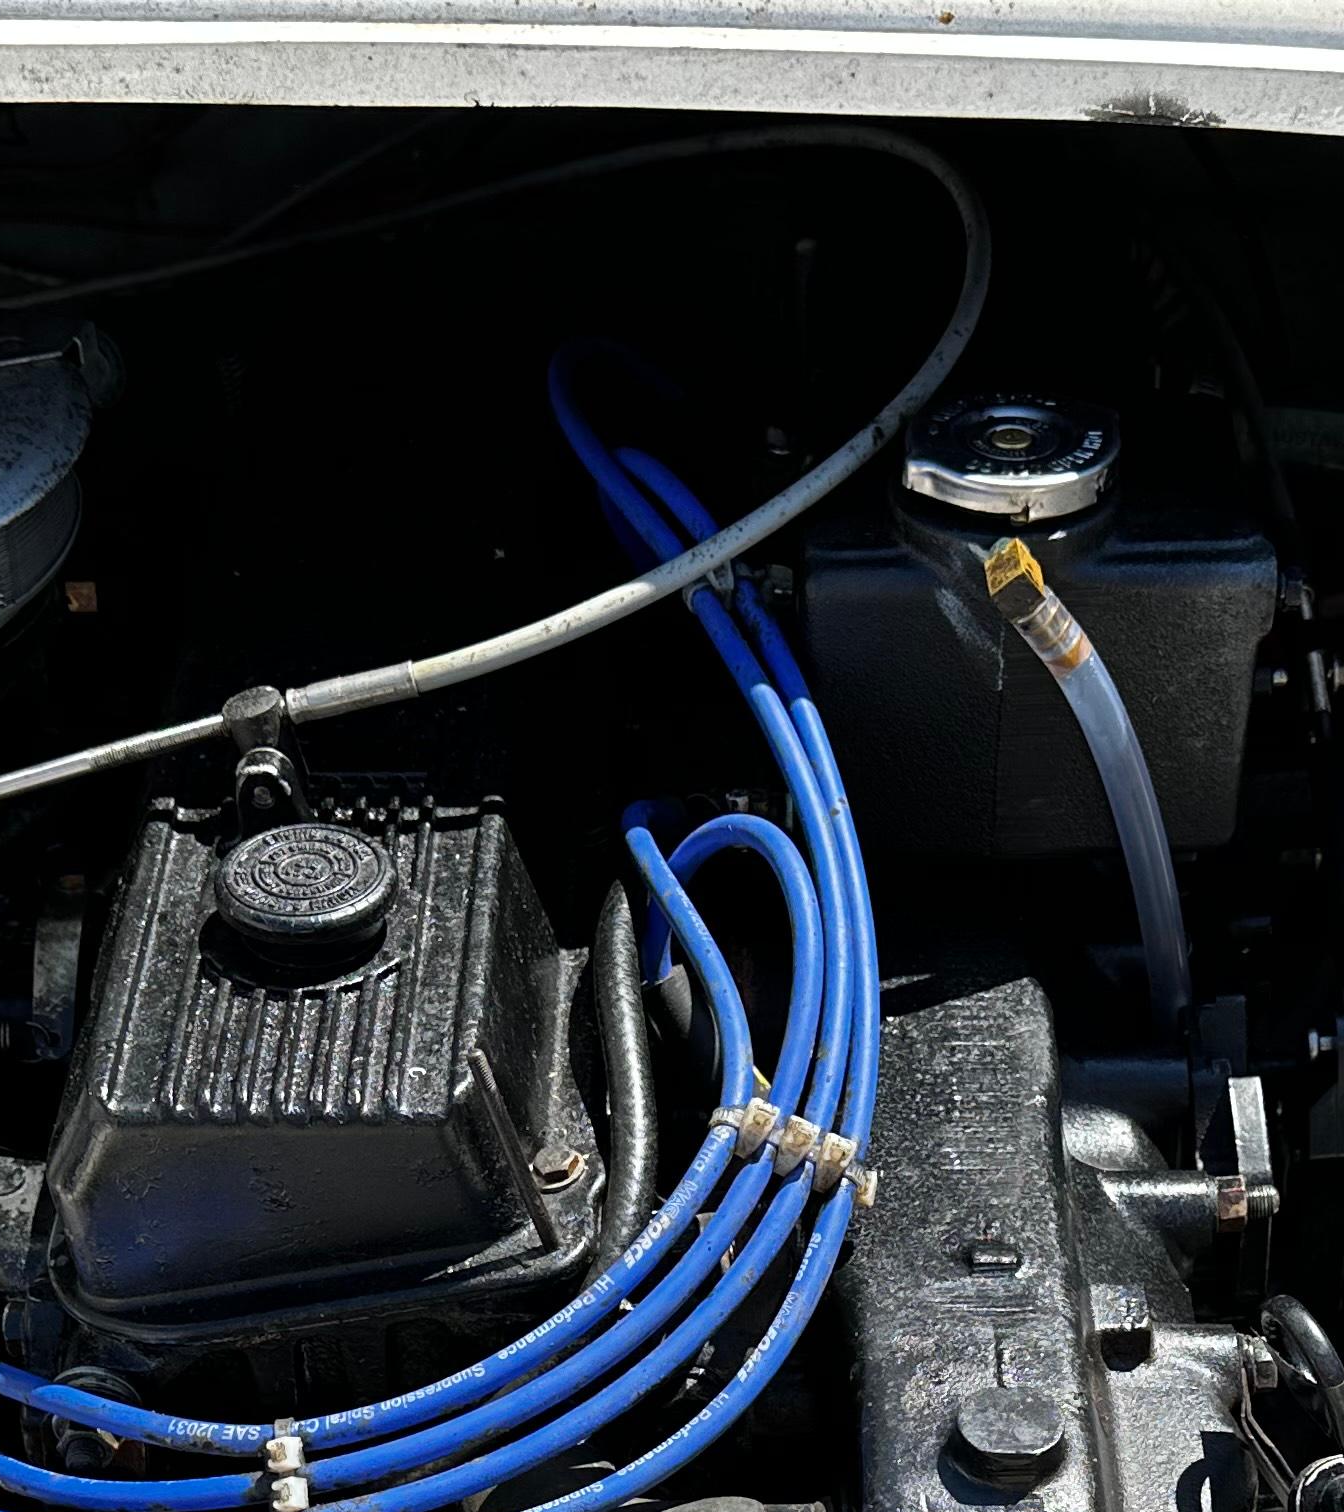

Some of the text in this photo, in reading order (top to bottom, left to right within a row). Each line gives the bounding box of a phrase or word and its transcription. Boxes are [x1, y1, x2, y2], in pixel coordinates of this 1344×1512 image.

[624, 1180, 697, 1270] MAGFORCE
[593, 1274, 615, 1296] Hi
[497, 1288, 597, 1361] Performance
[379, 1361, 486, 1413] Suppression
[167, 1418, 217, 1438] J2031
[222, 1424, 262, 1441] SAE
[324, 1404, 375, 1432] Spiral
[617, 1403, 715, 1477] Performance
